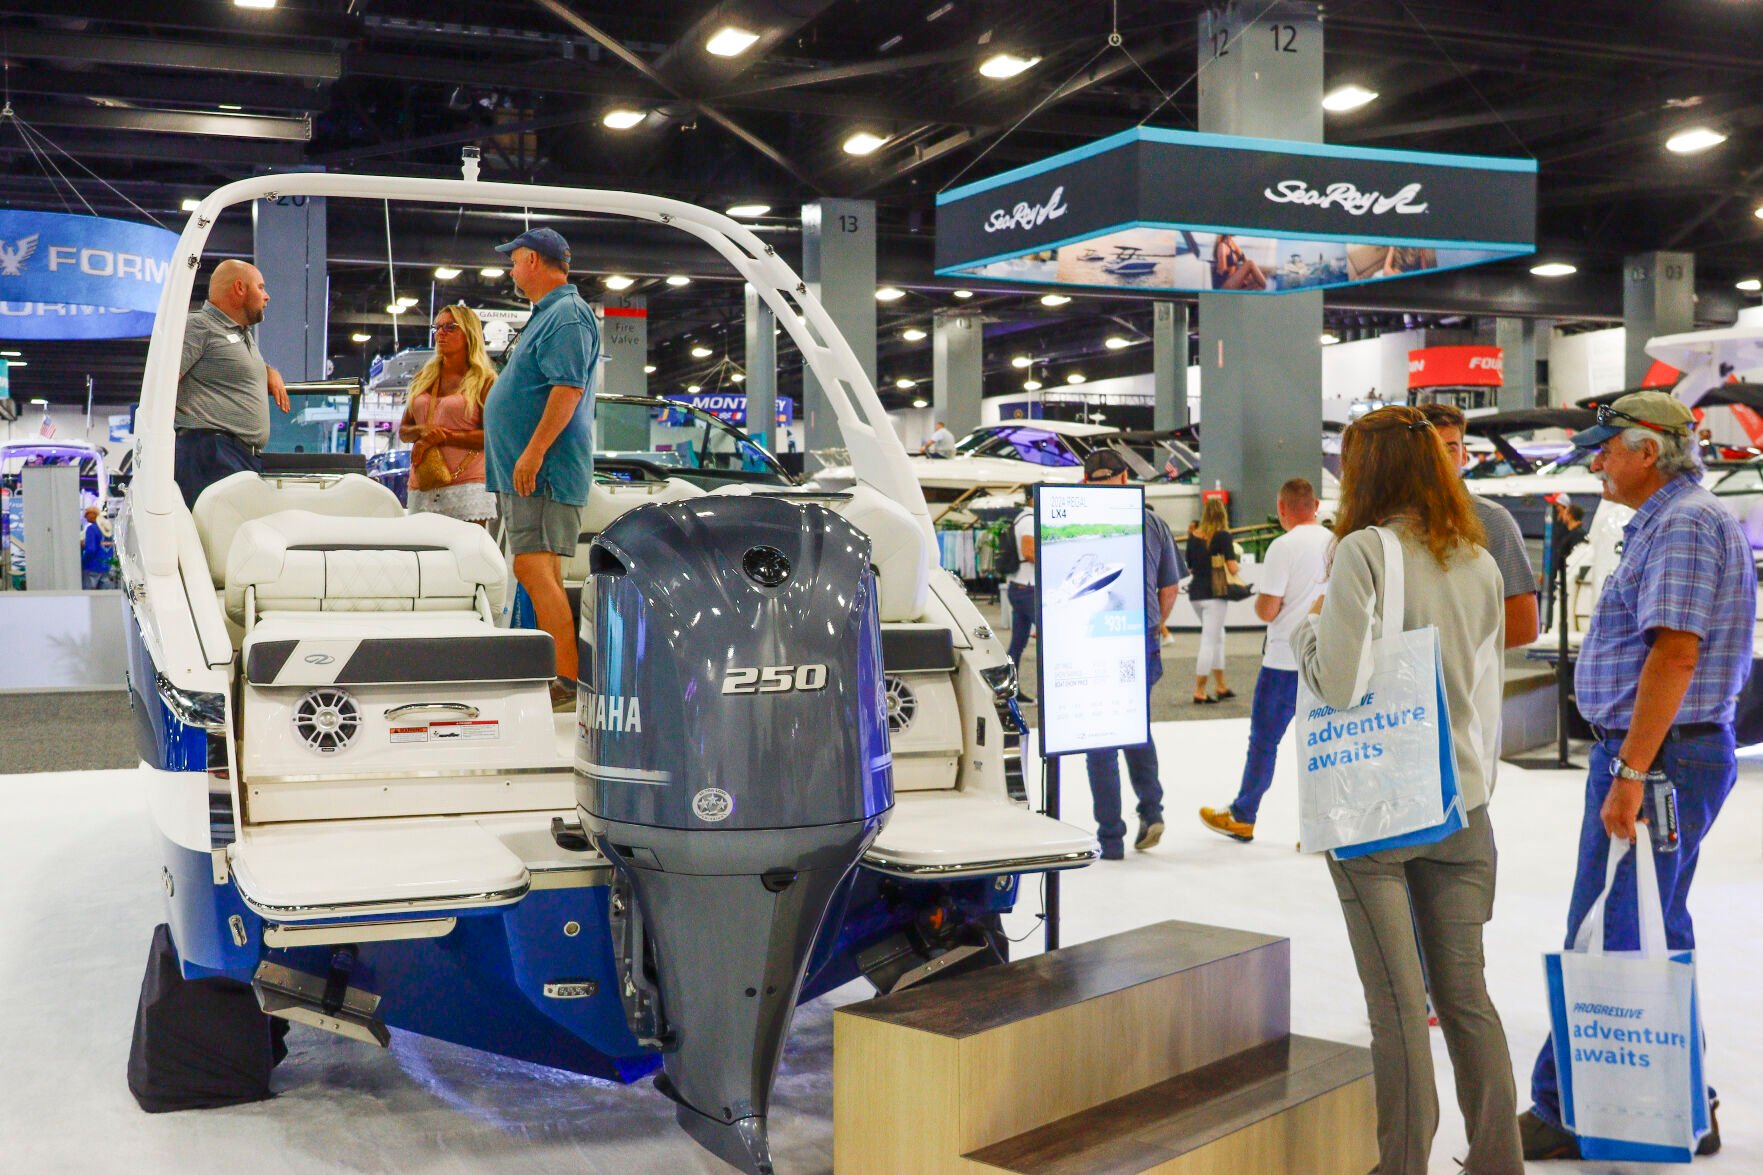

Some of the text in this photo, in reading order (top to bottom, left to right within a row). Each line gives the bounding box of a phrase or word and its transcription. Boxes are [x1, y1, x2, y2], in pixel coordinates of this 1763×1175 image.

[1270, 24, 1297, 53] 12
[839, 215, 859, 233] 13
[479, 311, 519, 319] GARMIN
[615, 322, 634, 333] Fire
[611, 335, 640, 345] Valve
[1051, 508, 1067, 519] LX4
[721, 664, 828, 695] 250
[1307, 705, 1426, 747] adventure
[1307, 741, 1384, 772] awaits
[1573, 1002, 1645, 1019] PROGRESSIVE
[1575, 1047, 1651, 1068] awaits
